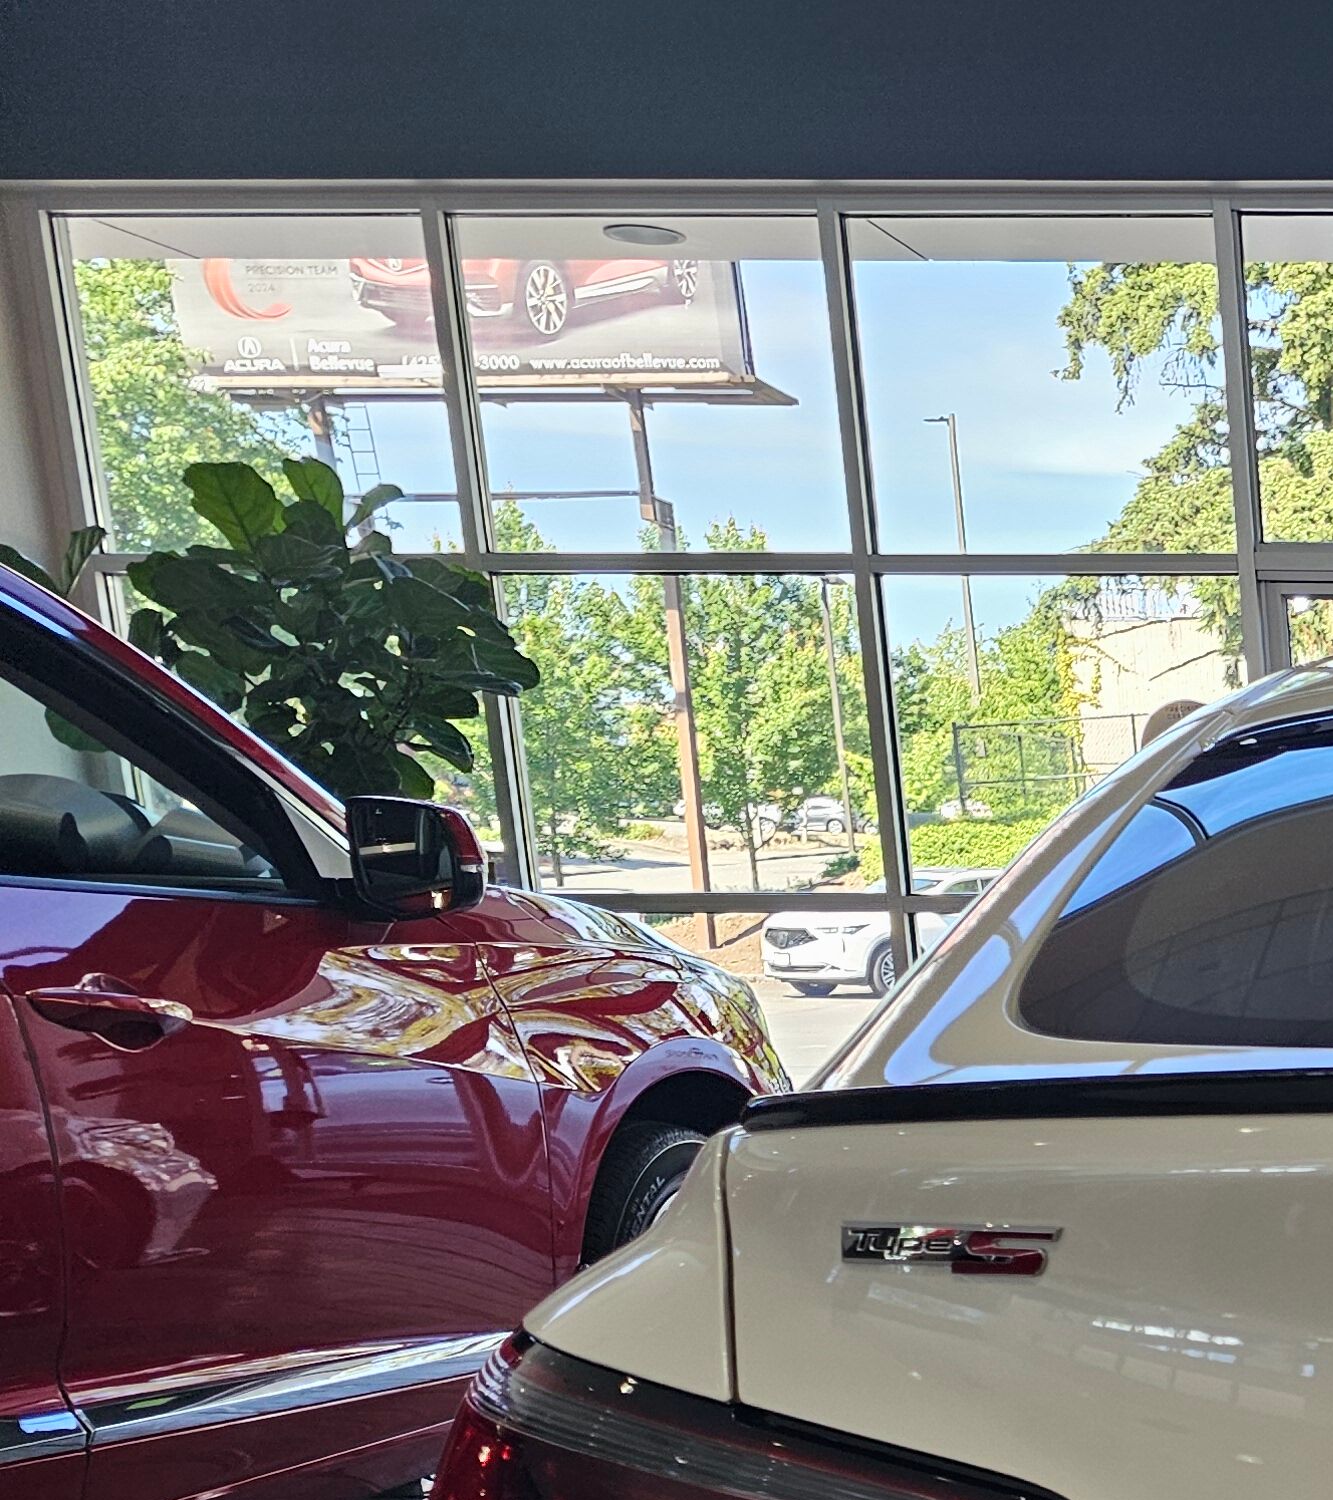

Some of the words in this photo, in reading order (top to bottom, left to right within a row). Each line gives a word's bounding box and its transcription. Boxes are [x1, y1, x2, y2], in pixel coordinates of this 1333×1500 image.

[307, 265, 338, 275] TEAM
[307, 339, 350, 354] Acura
[224, 359, 286, 373] ACURA
[308, 356, 375, 372] Bellevue
[529, 352, 721, 370] www.acuraofbellevue.com
